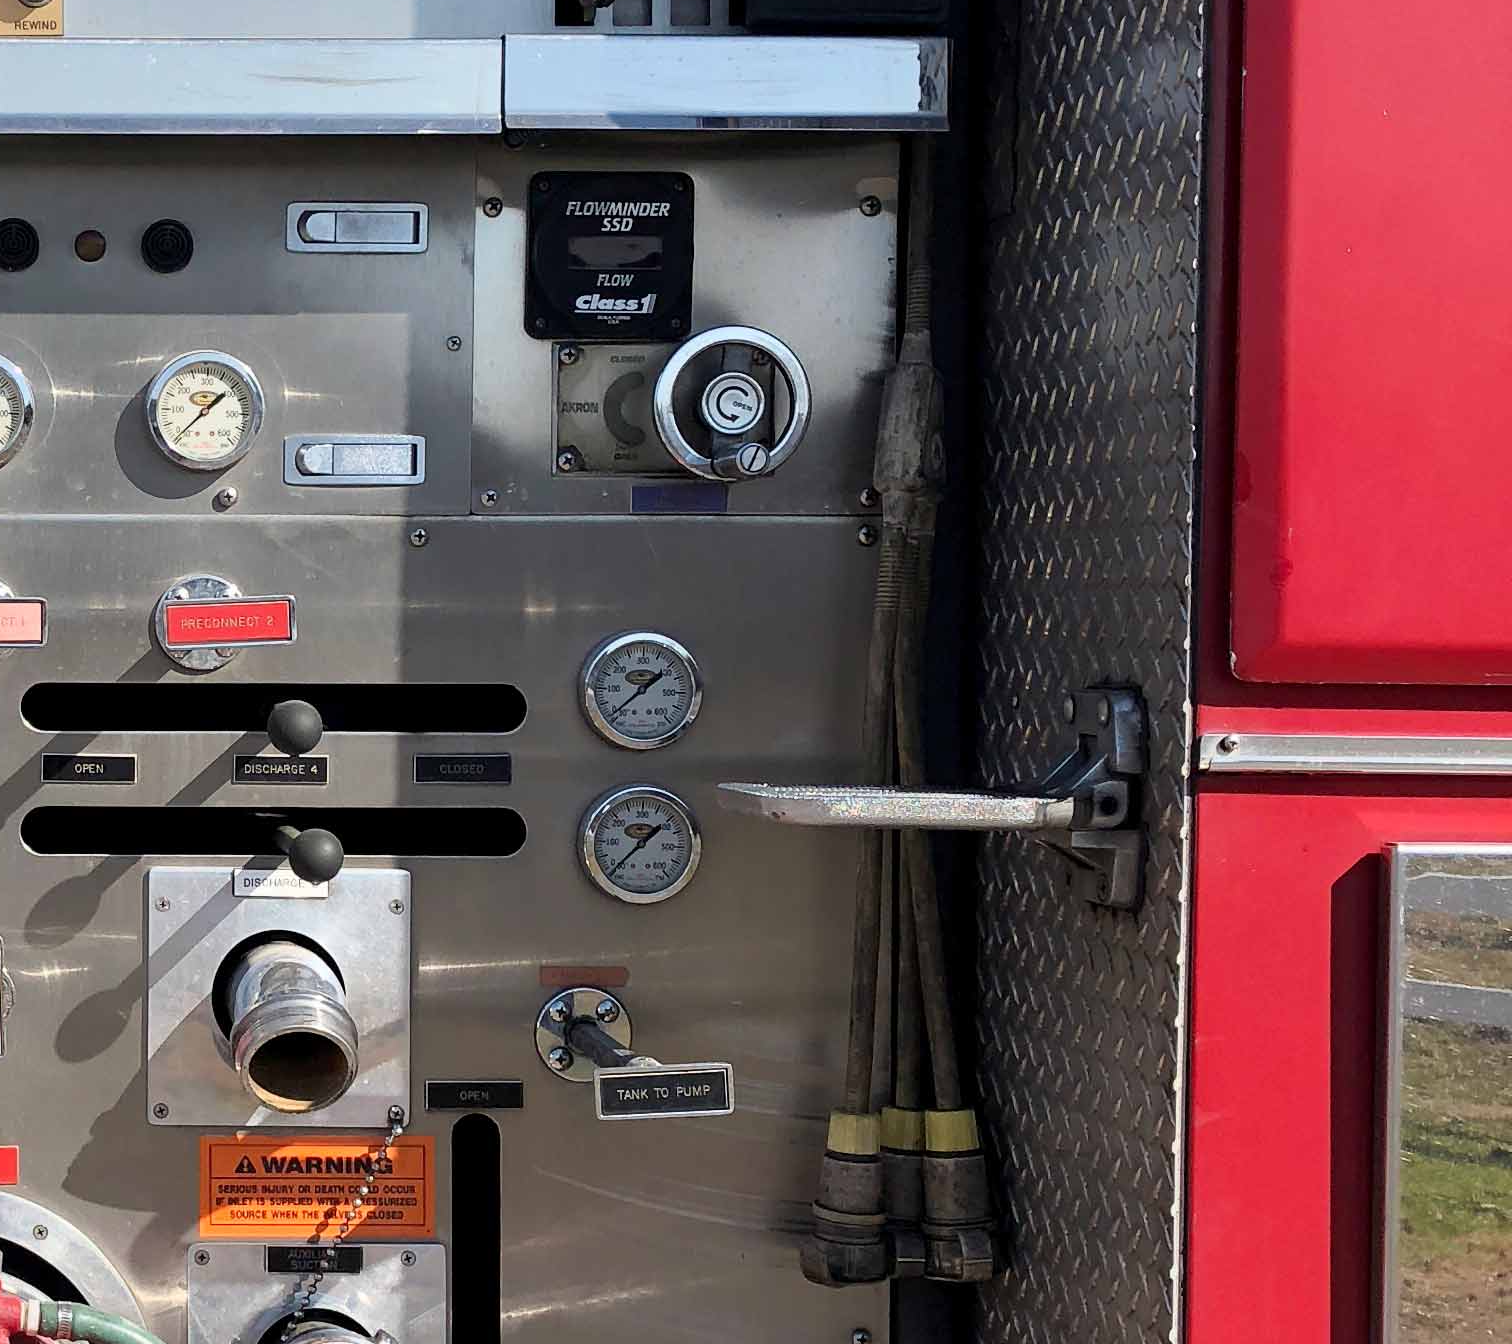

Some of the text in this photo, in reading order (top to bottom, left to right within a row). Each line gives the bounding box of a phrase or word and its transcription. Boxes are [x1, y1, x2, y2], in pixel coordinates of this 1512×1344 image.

[14, 20, 57, 31] REWIND
[566, 201, 671, 217] FLOWMINDER
[601, 217, 634, 232] SSD
[596, 273, 635, 287] FLOW
[560, 401, 599, 414] AKRON
[732, 400, 753, 412] OPEN
[180, 614, 274, 631] PRECONNECT 2
[74, 763, 104, 775] OPEN
[244, 763, 318, 775] DISCHARGE 4
[439, 763, 484, 775] CLOSED
[243, 877, 304, 889] DISCHARGE
[459, 1089, 489, 1101] OPEN
[617, 1084, 711, 1101] TANK TO PUMP
[260, 1155, 394, 1175] WARNING
[217, 1184, 258, 1194] SERIOUS
[261, 1184, 294, 1194] INJURY
[298, 1184, 312, 1194] OR
[314, 1184, 345, 1194] DEATH
[383, 1183, 416, 1194] OCCUR
[227, 1197, 252, 1206] INLET
[255, 1197, 266, 1206] IS
[269, 1197, 313, 1206] SUPPLIED
[317, 1197, 339, 1206] WITH
[343, 1197, 350, 1206] A
[352, 1197, 418, 1206] RESSURIZED
[230, 1210, 267, 1220] SOURCE
[271, 1210, 299, 1220] WHEN
[302, 1210, 319, 1220] THE
[366, 1210, 404, 1220] CLOSED
